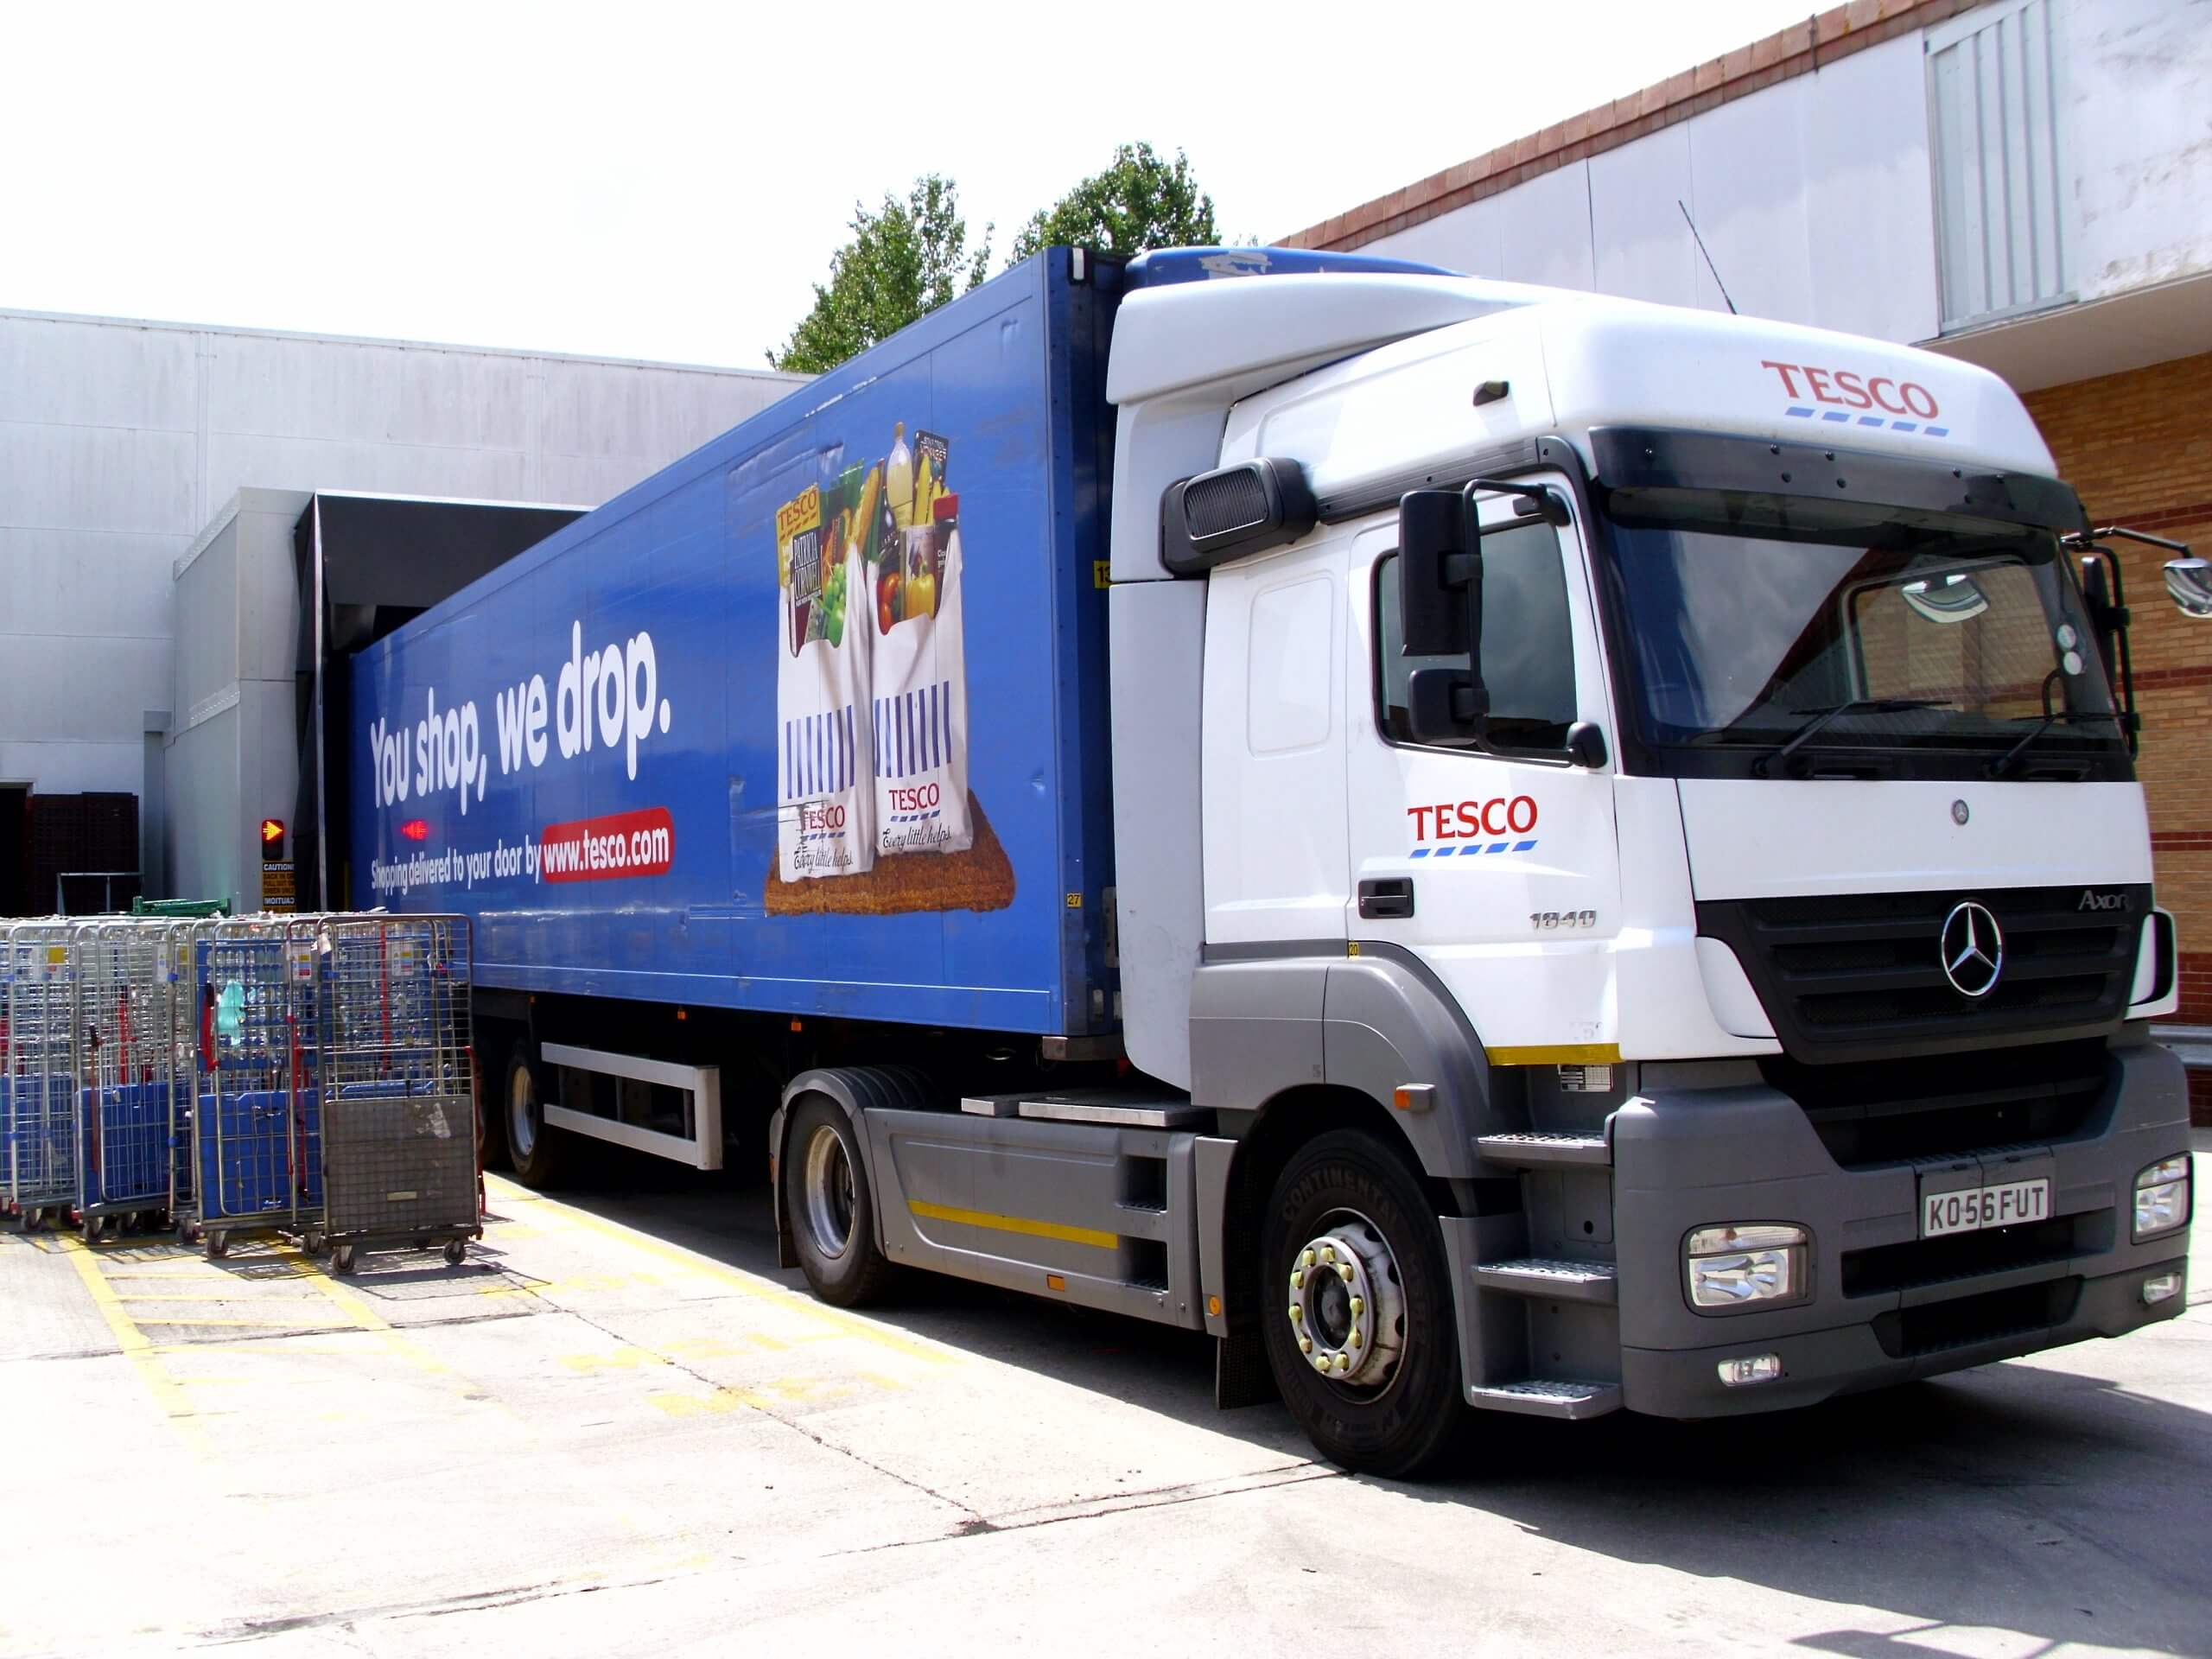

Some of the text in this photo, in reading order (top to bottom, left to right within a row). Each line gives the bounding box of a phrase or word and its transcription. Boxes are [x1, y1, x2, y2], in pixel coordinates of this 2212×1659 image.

[1761, 360, 1939, 419] TESCO
[779, 490, 817, 531] TESCO
[371, 620, 671, 816] You shop, we drop.
[889, 783, 939, 810] TESCO
[802, 805, 845, 831] TESCO
[1408, 795, 1538, 842] TESCO
[882, 828, 906, 851] Every
[906, 825, 926, 845] little
[372, 827, 669, 896] Shopping delivered to your door by www.tesco.com
[793, 847, 815, 874] Every
[815, 847, 831, 867] little
[1068, 894, 1079, 905] 27
[2077, 889, 2133, 912] Axor
[1529, 909, 1598, 930] 1840
